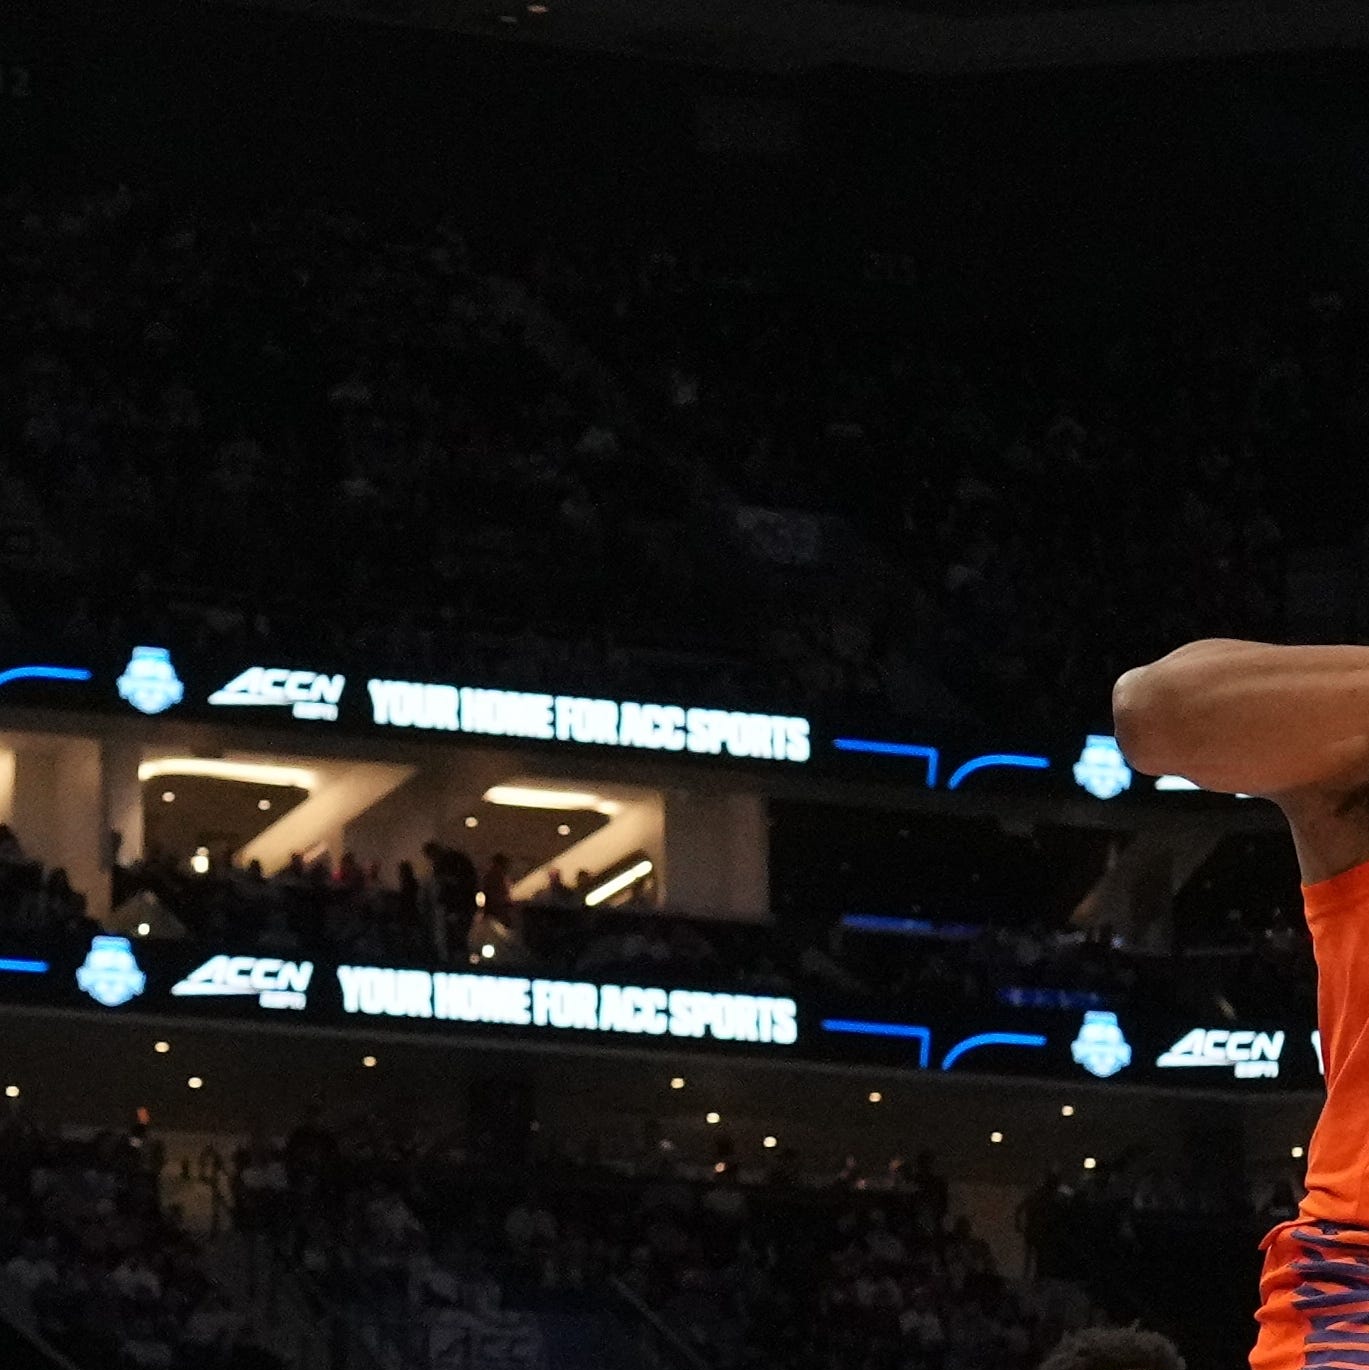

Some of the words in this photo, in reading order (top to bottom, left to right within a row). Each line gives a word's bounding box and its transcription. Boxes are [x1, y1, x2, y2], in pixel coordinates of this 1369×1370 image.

[207, 666, 346, 706] ACCN
[366, 678, 460, 732] YOUR
[460, 686, 554, 740] HOME
[555, 695, 619, 746] FOR
[619, 701, 687, 751] ACC
[687, 707, 811, 763] SPORTS
[170, 954, 314, 996] ACCN
[336, 964, 433, 1018] YOUR
[433, 972, 532, 1026] HOME
[531, 978, 599, 1030] FOR
[599, 984, 668, 1035] ACC
[667, 990, 798, 1045] SPORTS
[1156, 1027, 1285, 1067] ACCN
